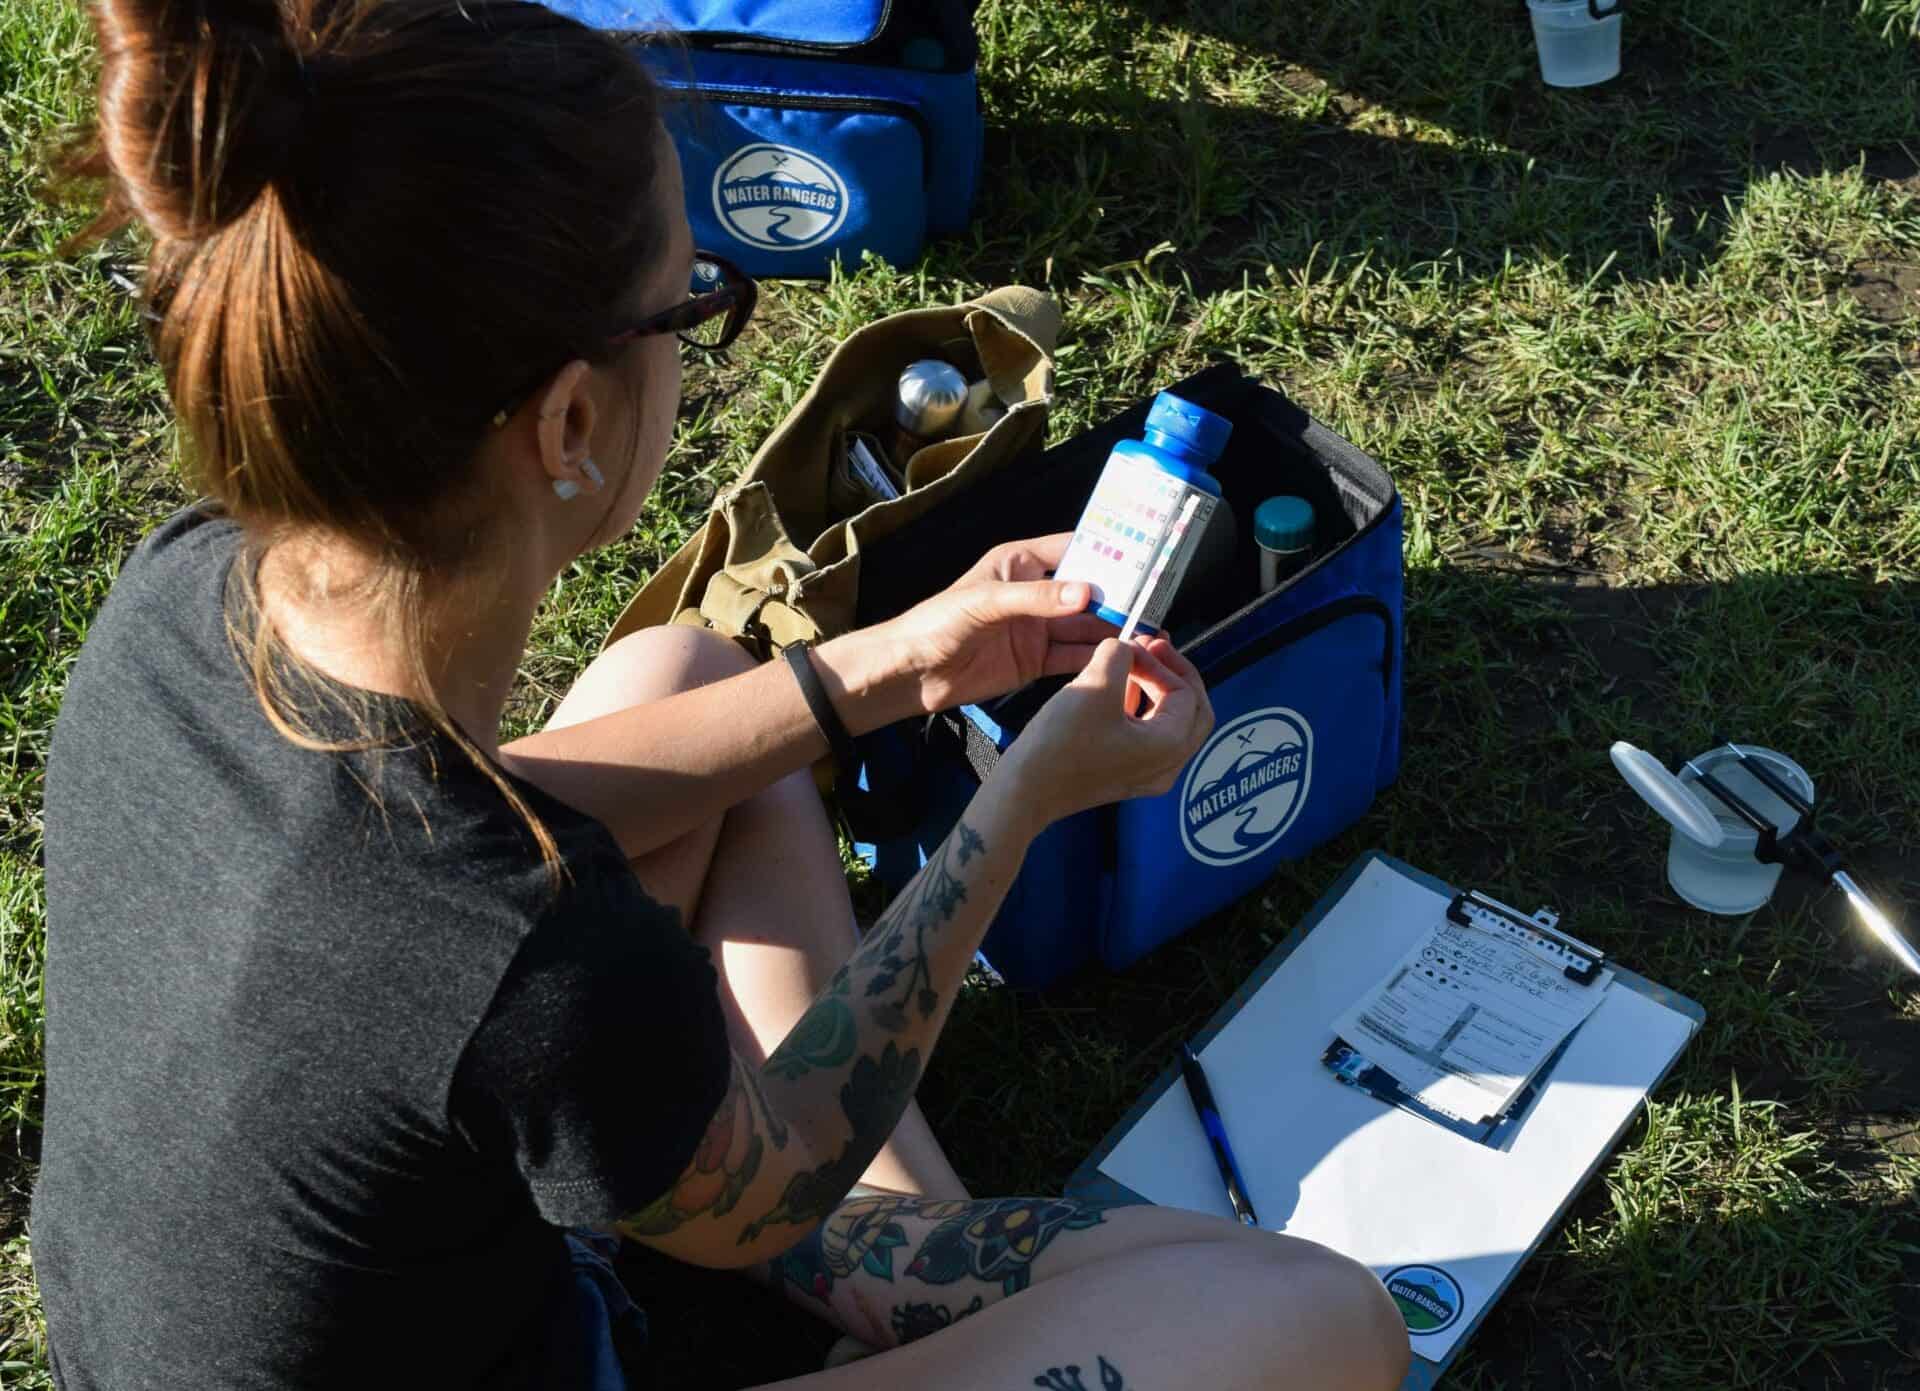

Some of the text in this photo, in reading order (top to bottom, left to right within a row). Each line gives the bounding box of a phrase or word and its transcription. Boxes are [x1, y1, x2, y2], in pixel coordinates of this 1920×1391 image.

[723, 185, 837, 210] WATER RANGERS
[1188, 753, 1301, 825] WATER RANGERS
[1391, 1283, 1417, 1301] WATER
